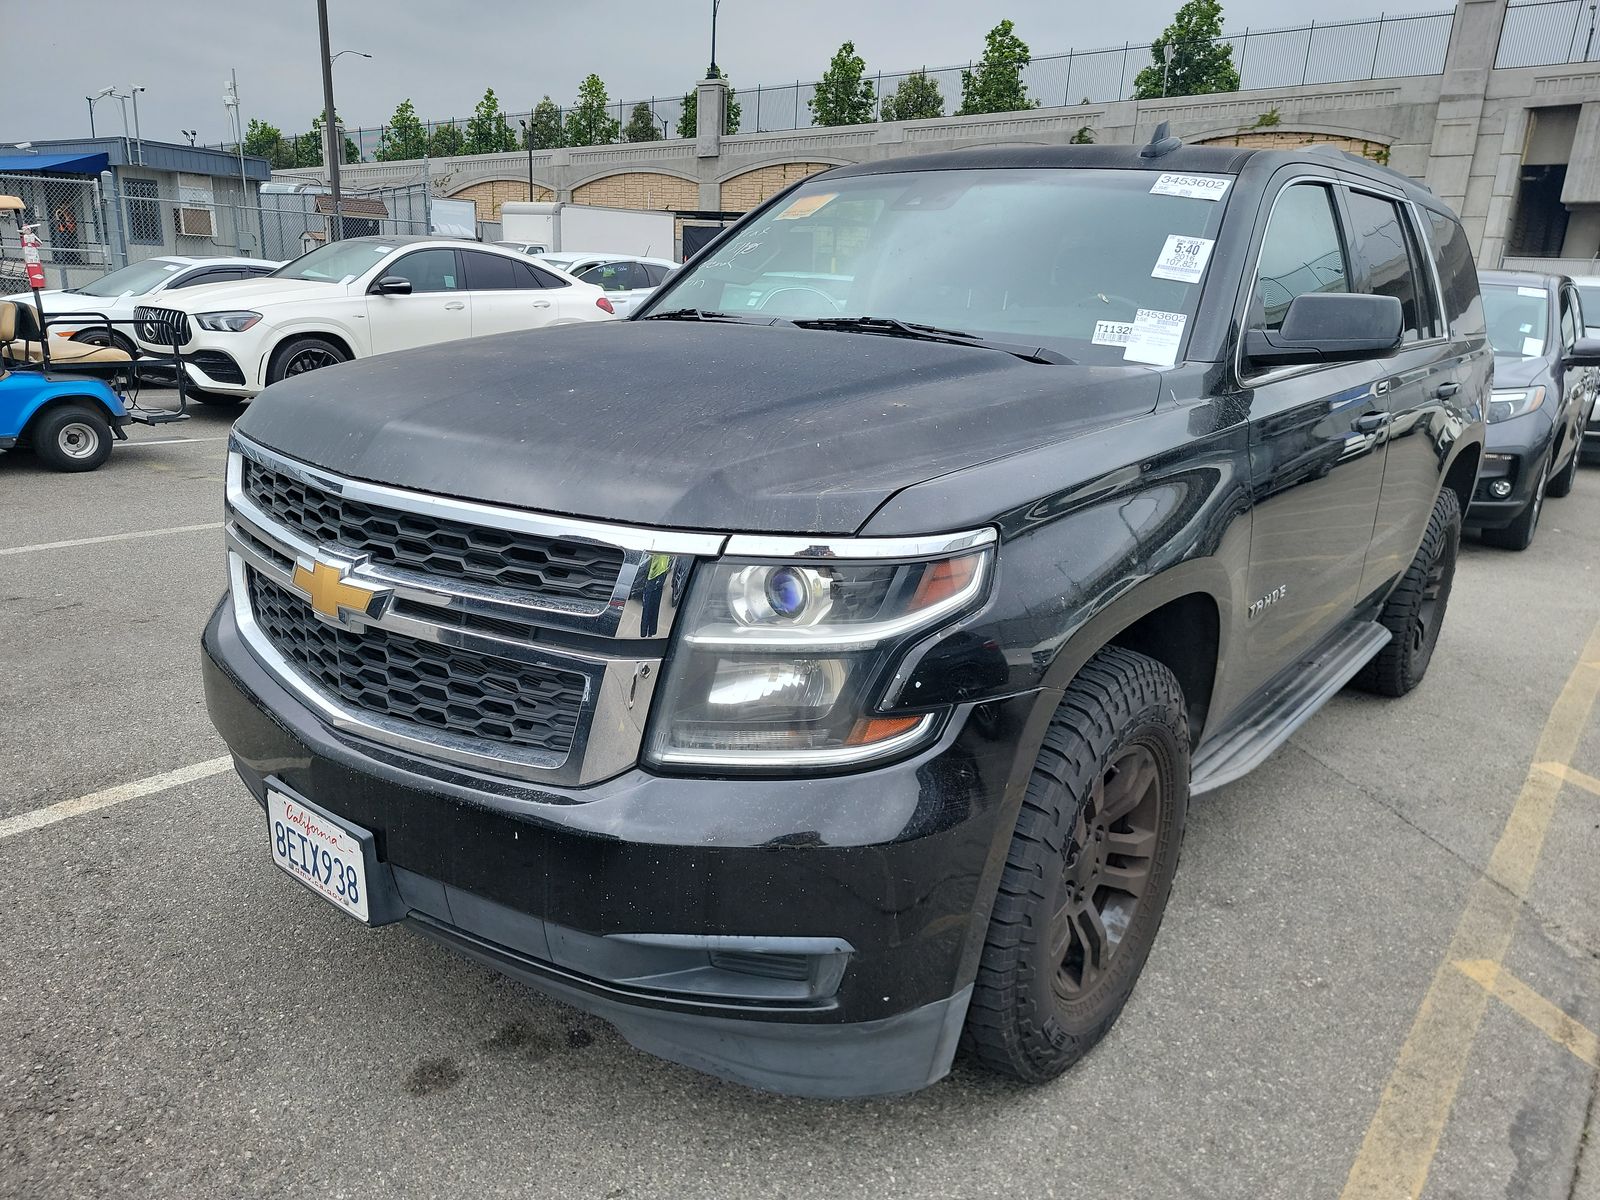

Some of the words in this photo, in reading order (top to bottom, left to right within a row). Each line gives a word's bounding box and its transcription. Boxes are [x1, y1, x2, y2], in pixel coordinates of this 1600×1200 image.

[1161, 175, 1225, 190] 3453602
[1174, 242, 1200, 256] 5:40
[1174, 253, 1195, 261] 2016
[1136, 309, 1186, 323] 3453602
[1248, 584, 1286, 619] TAHOE
[286, 804, 344, 853] California
[275, 821, 359, 904] 8EIX938
[294, 867, 344, 902] dmv.ca.gov
